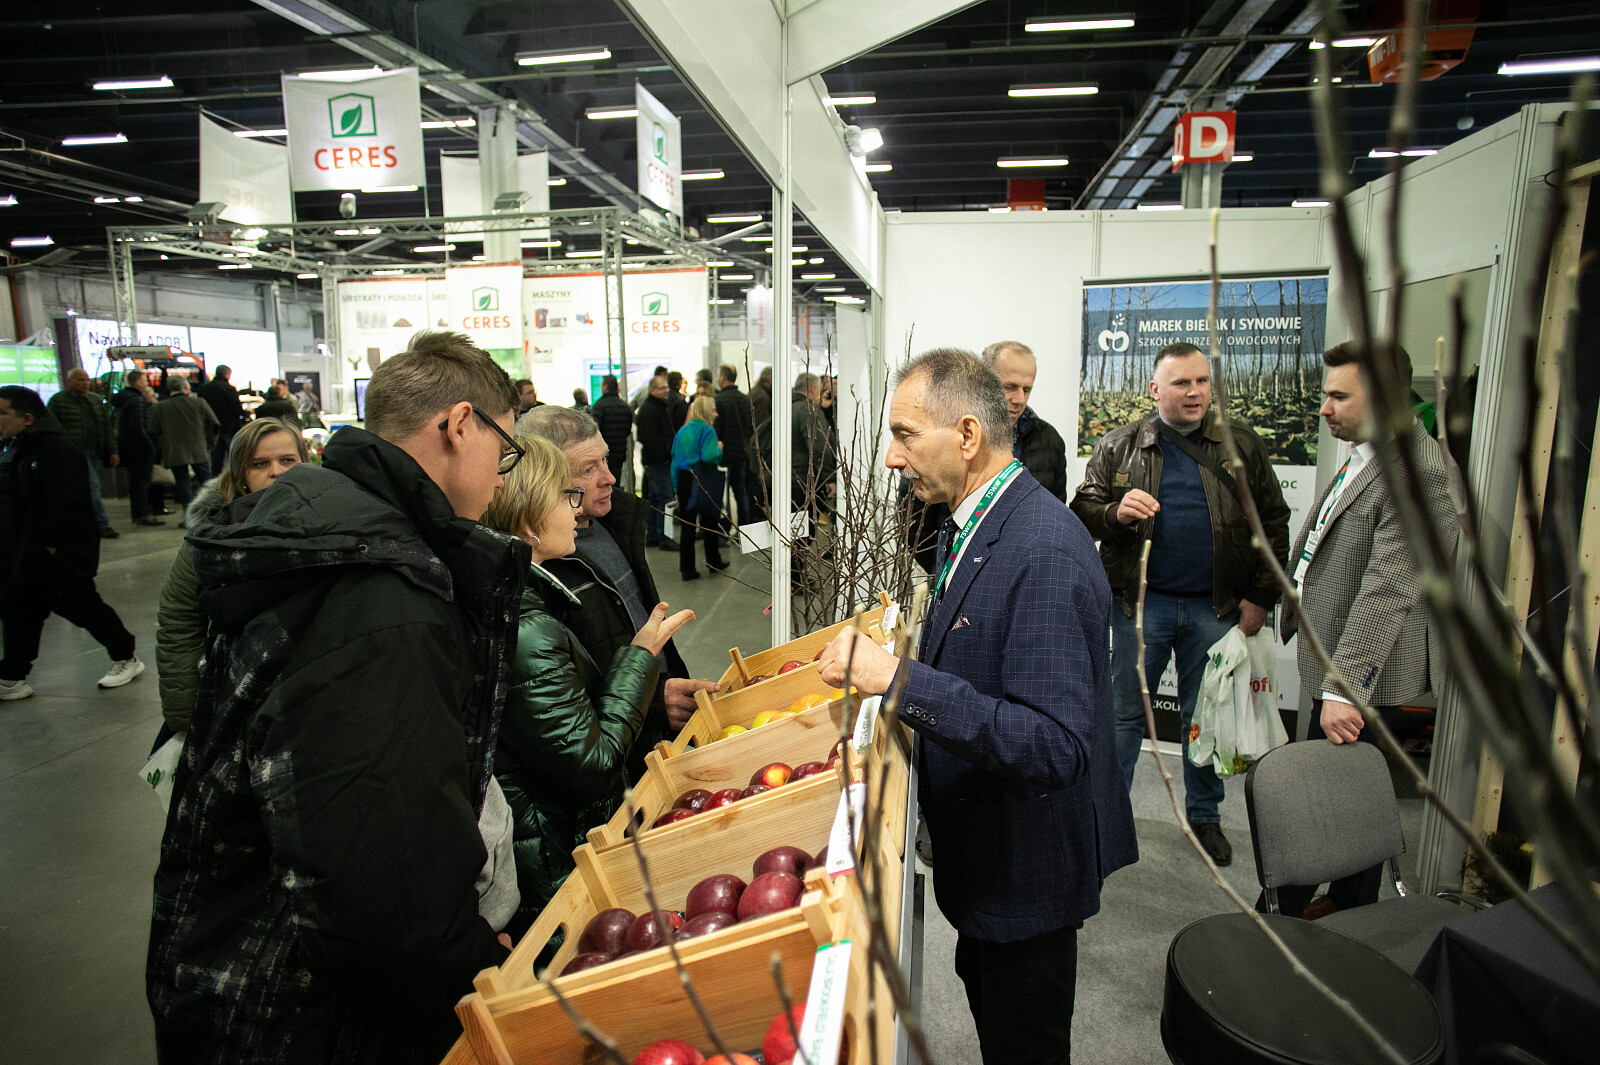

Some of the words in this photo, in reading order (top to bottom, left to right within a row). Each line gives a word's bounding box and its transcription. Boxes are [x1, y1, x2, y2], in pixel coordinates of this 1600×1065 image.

[1189, 116, 1229, 158] D
[314, 145, 397, 170] CERES
[532, 290, 571, 298] MASZYNY
[462, 316, 511, 329] CERES
[631, 320, 680, 333] CERES
[1139, 320, 1183, 332] MAREK
[1239, 316, 1302, 331] SYNOWIE
[1227, 334, 1301, 346] OWOCOWYCH
[985, 484, 998, 499] TSW
